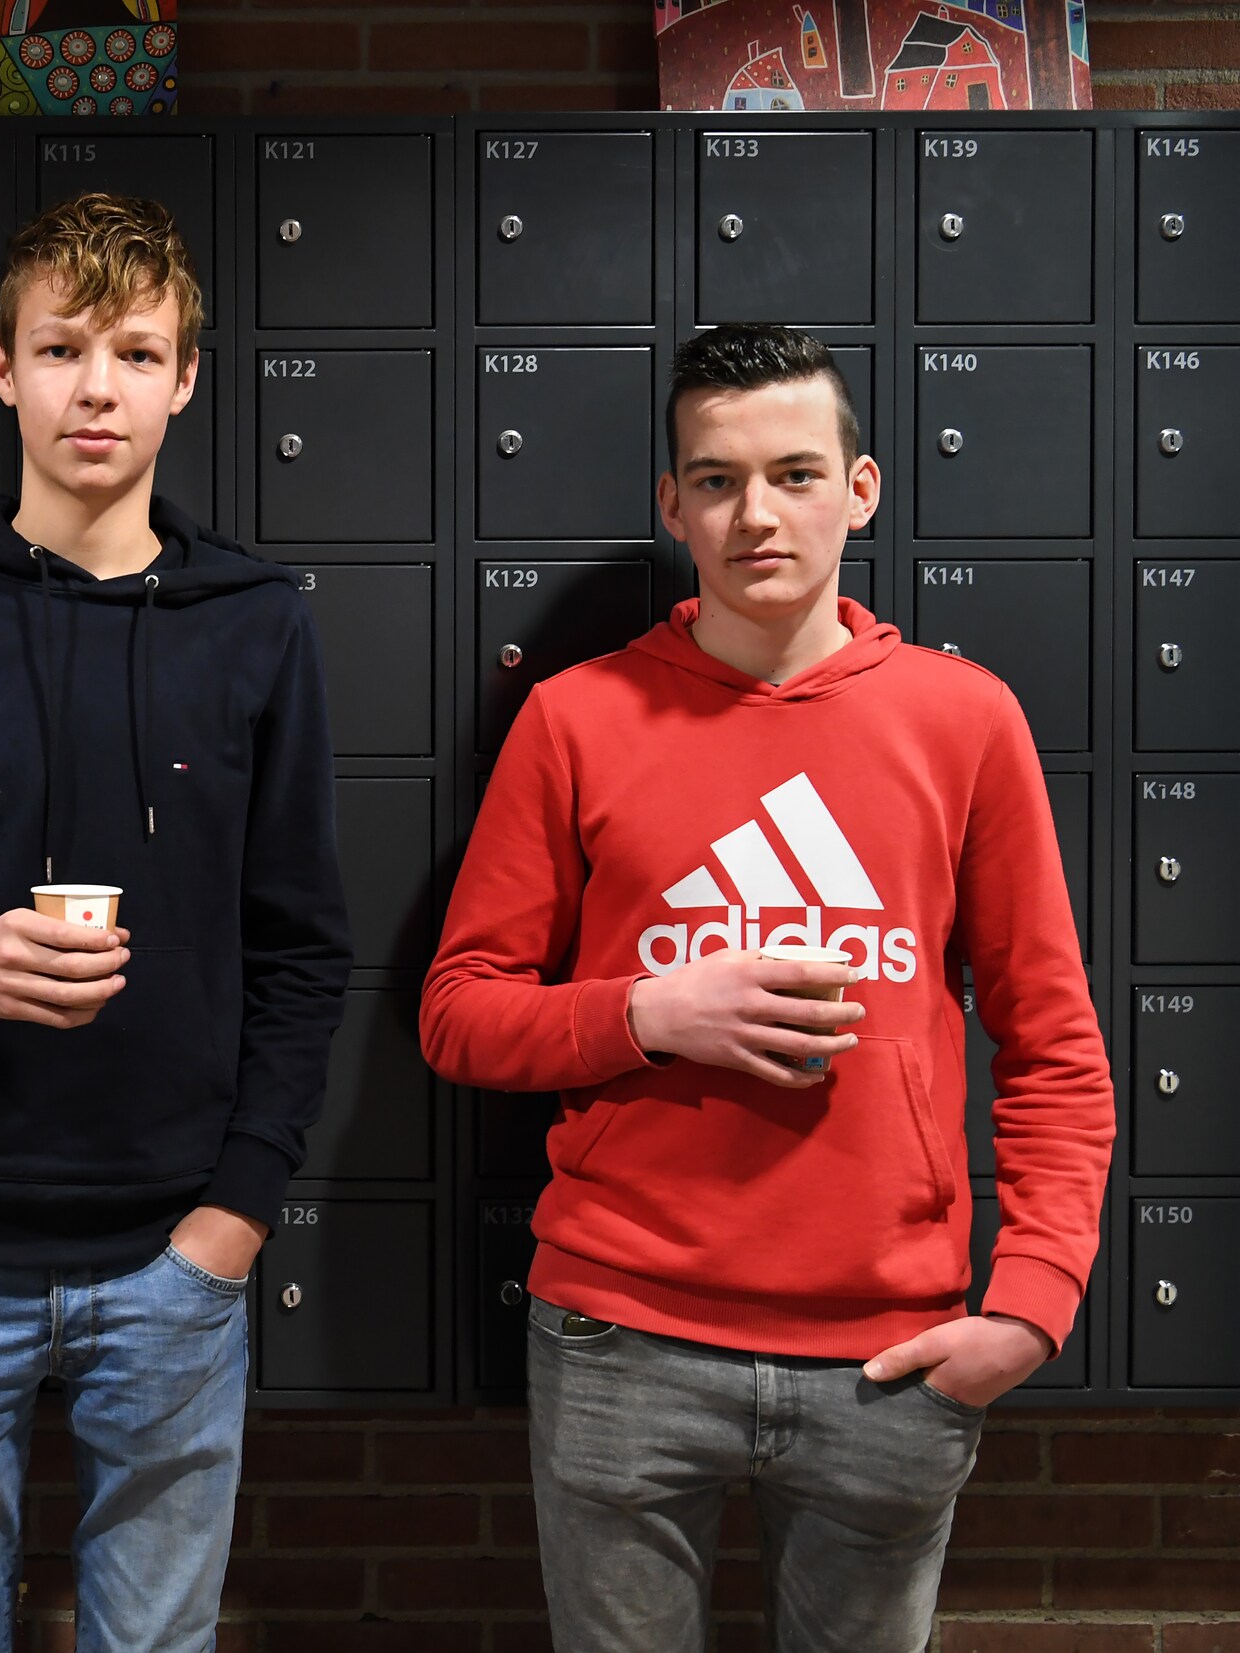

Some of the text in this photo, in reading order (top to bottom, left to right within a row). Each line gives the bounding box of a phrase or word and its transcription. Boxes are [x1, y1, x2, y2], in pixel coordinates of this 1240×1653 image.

[45, 144, 95, 161] K115
[265, 141, 314, 159] K121
[487, 141, 538, 158] K127
[708, 140, 758, 156] K133
[925, 139, 977, 157] K139
[1148, 139, 1199, 156] K145
[265, 360, 315, 377] K122
[486, 355, 537, 372] K128
[925, 354, 977, 371] K140
[1148, 351, 1199, 369] K146
[486, 570, 537, 587] K129
[924, 567, 972, 584] K141
[1143, 569, 1195, 586] K147
[1142, 995, 1193, 1012] K149
[282, 1208, 318, 1224] 126
[1141, 1206, 1192, 1223] K150
